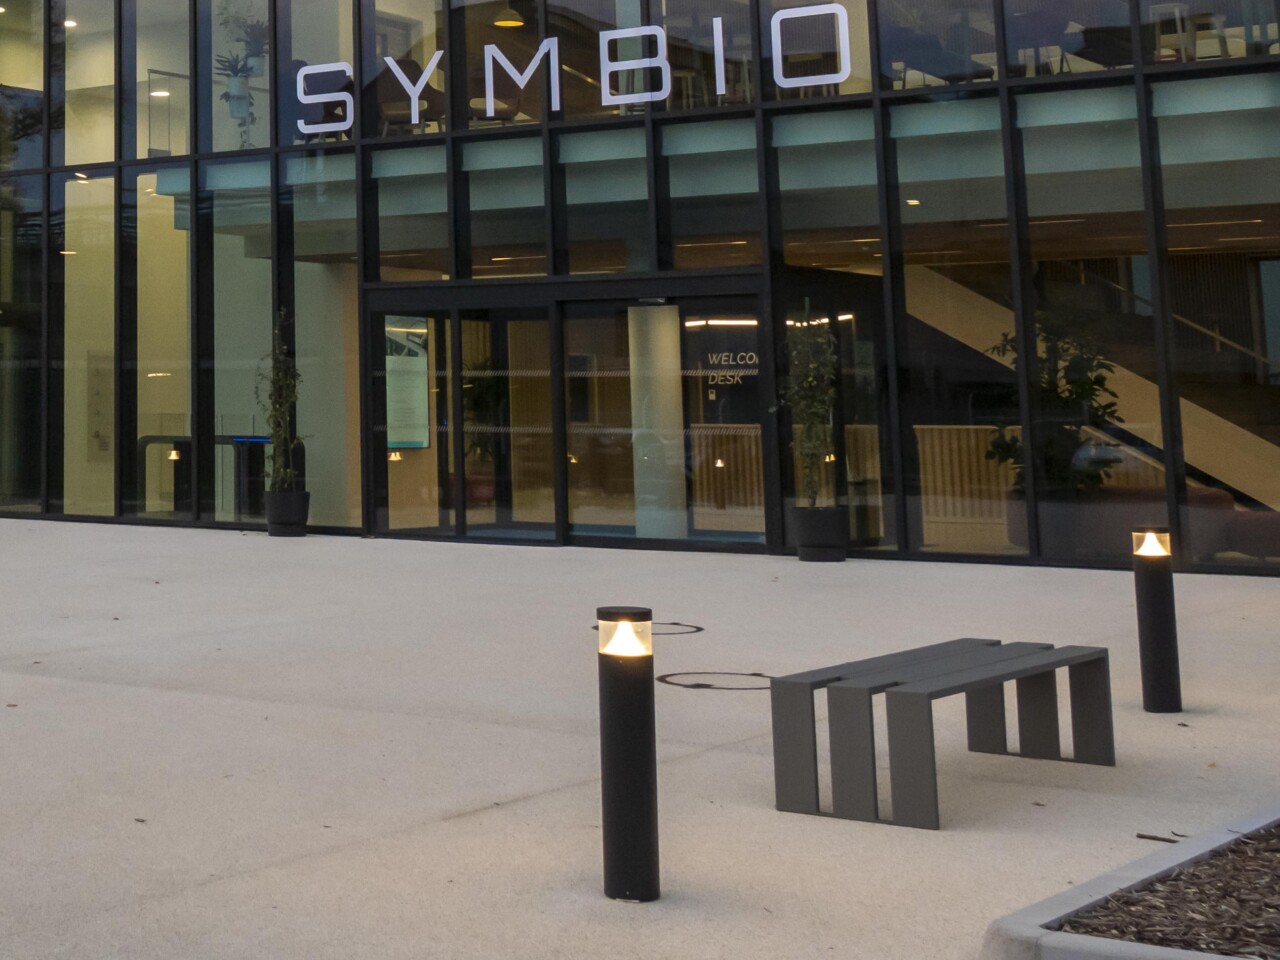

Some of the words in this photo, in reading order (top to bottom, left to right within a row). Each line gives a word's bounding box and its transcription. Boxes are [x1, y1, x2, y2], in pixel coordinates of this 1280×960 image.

[297, 3, 851, 134] SYMBIO
[708, 352, 758, 365] WELCO
[708, 373, 742, 385] DESK
